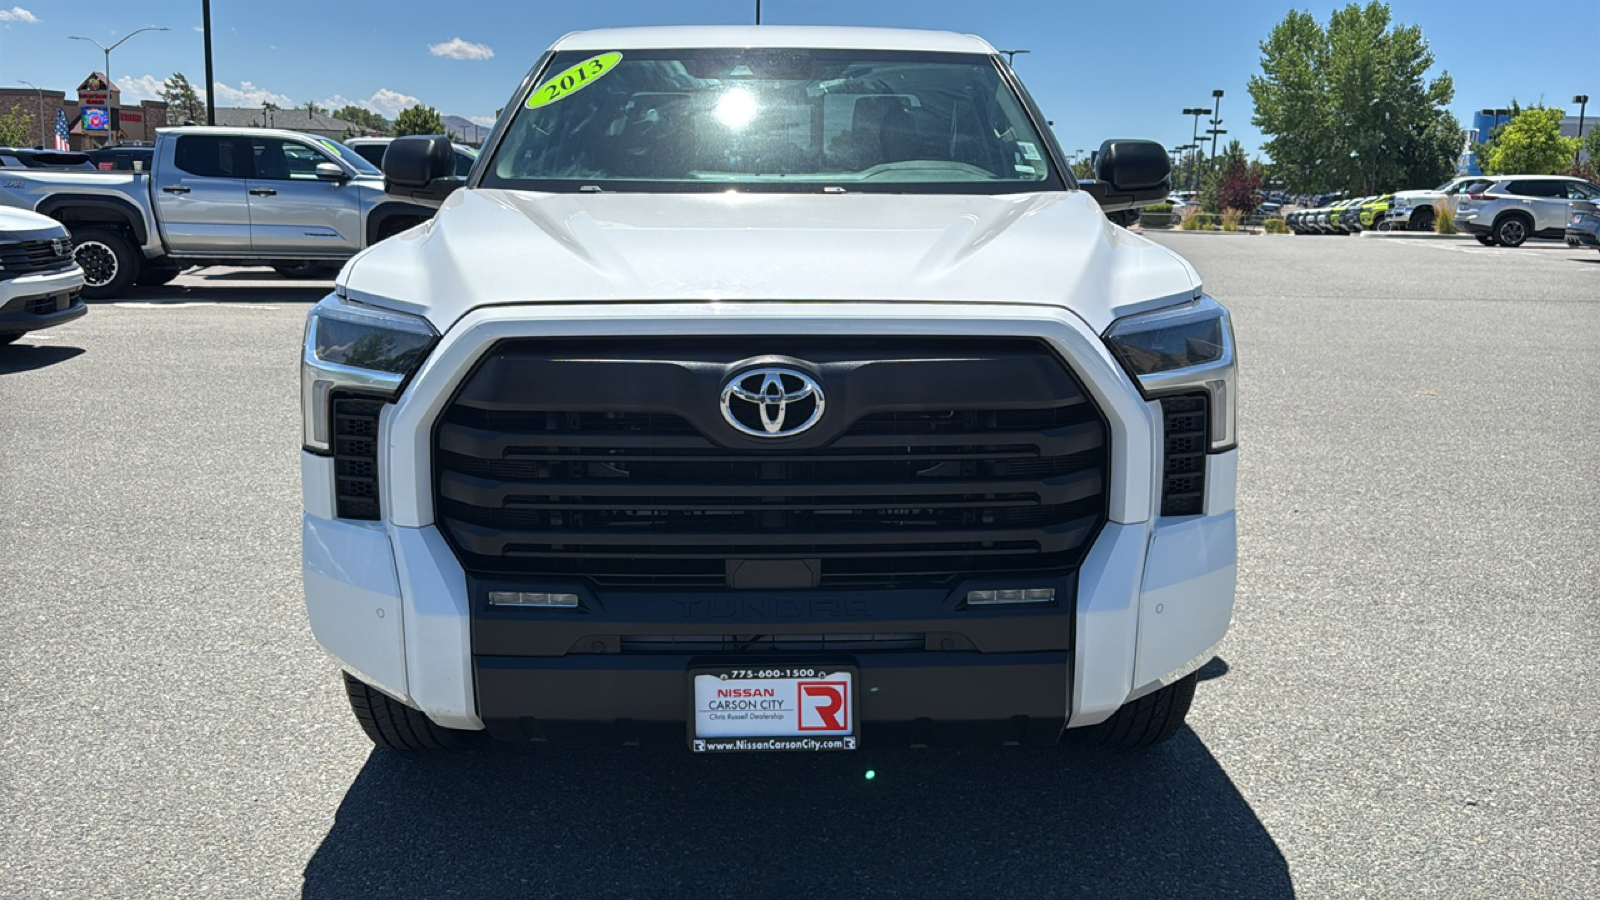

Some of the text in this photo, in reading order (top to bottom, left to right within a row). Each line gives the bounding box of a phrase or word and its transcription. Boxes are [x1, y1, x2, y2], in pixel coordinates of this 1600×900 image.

[544, 59, 603, 101] 2013
[672, 598, 874, 619] TUNDRA
[731, 669, 815, 679] 775-600-1500
[716, 688, 775, 698] NISSAN
[708, 699, 784, 710] CARSON CITY
[709, 713, 726, 721] Chris
[749, 712, 784, 721] Dealership
[706, 738, 842, 751] www.NissanCarsonCity.com
